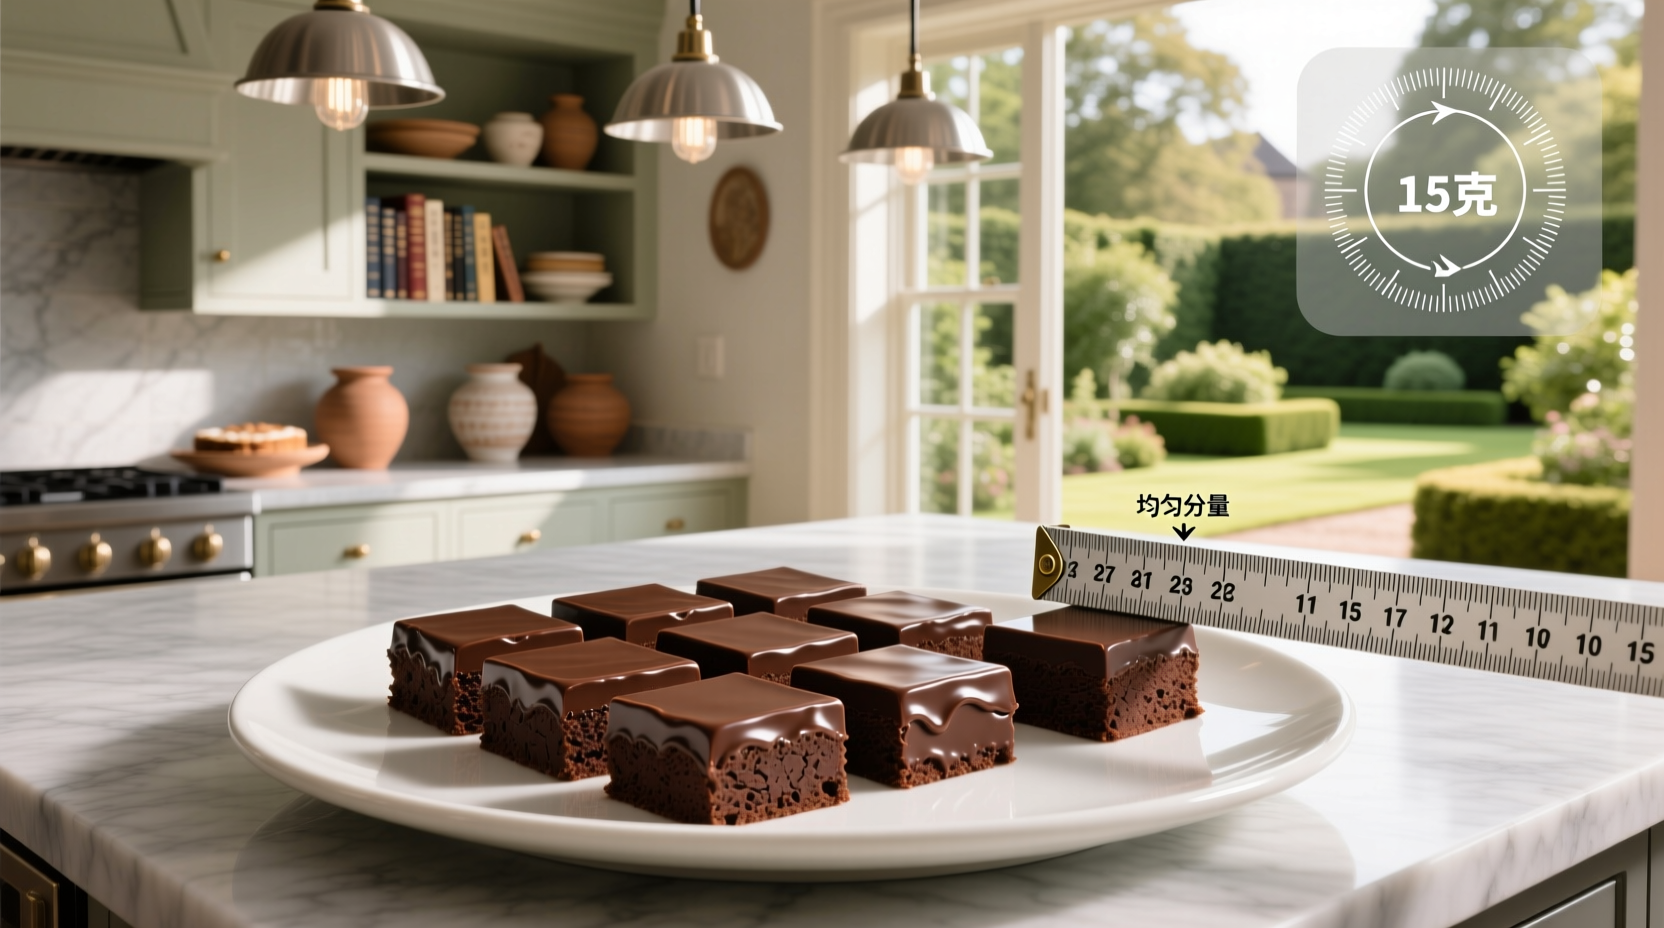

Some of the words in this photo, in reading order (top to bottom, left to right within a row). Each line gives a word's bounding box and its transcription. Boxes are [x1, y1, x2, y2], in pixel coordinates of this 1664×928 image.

[1093, 563, 1116, 583] 27
[1296, 594, 1317, 615] 11
[1339, 600, 1362, 622] 15
[1384, 607, 1408, 628] 17
[1430, 613, 1454, 635] 12
[1478, 620, 1498, 642] 11
[1525, 627, 1551, 649] 10
[1576, 633, 1602, 657] 10
[1627, 641, 1655, 664] 15
